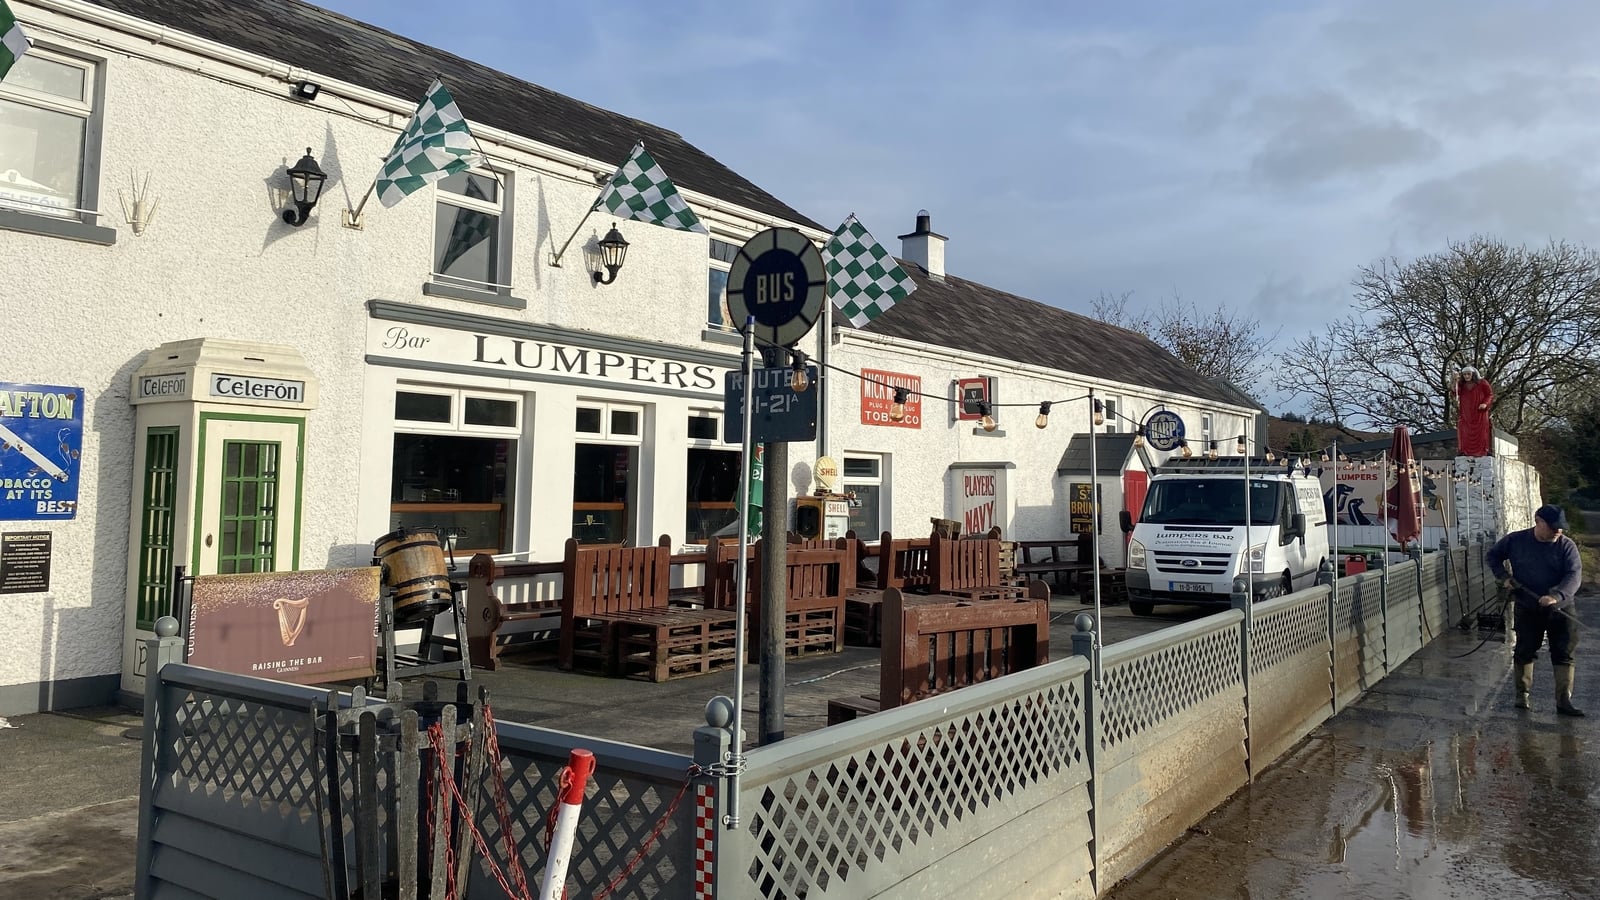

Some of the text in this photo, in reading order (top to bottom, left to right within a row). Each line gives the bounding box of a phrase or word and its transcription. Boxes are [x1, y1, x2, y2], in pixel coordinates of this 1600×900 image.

[756, 272, 795, 305] BUS
[383, 326, 717, 391] Bar LUMPERS
[864, 372, 886, 400] MICK
[864, 410, 920, 425] TOBCO
[1151, 421, 1177, 439] HARP
[821, 468, 838, 476] SHELL
[1336, 473, 1378, 481] LUMPERS
[6, 489, 53, 500] AT ITS
[37, 500, 76, 513] BEST
[828, 503, 847, 513] SHELL
[965, 500, 994, 537] NAVY
[187, 603, 197, 657] GUINNESS
[252, 656, 323, 671] RAISING THE BAR
